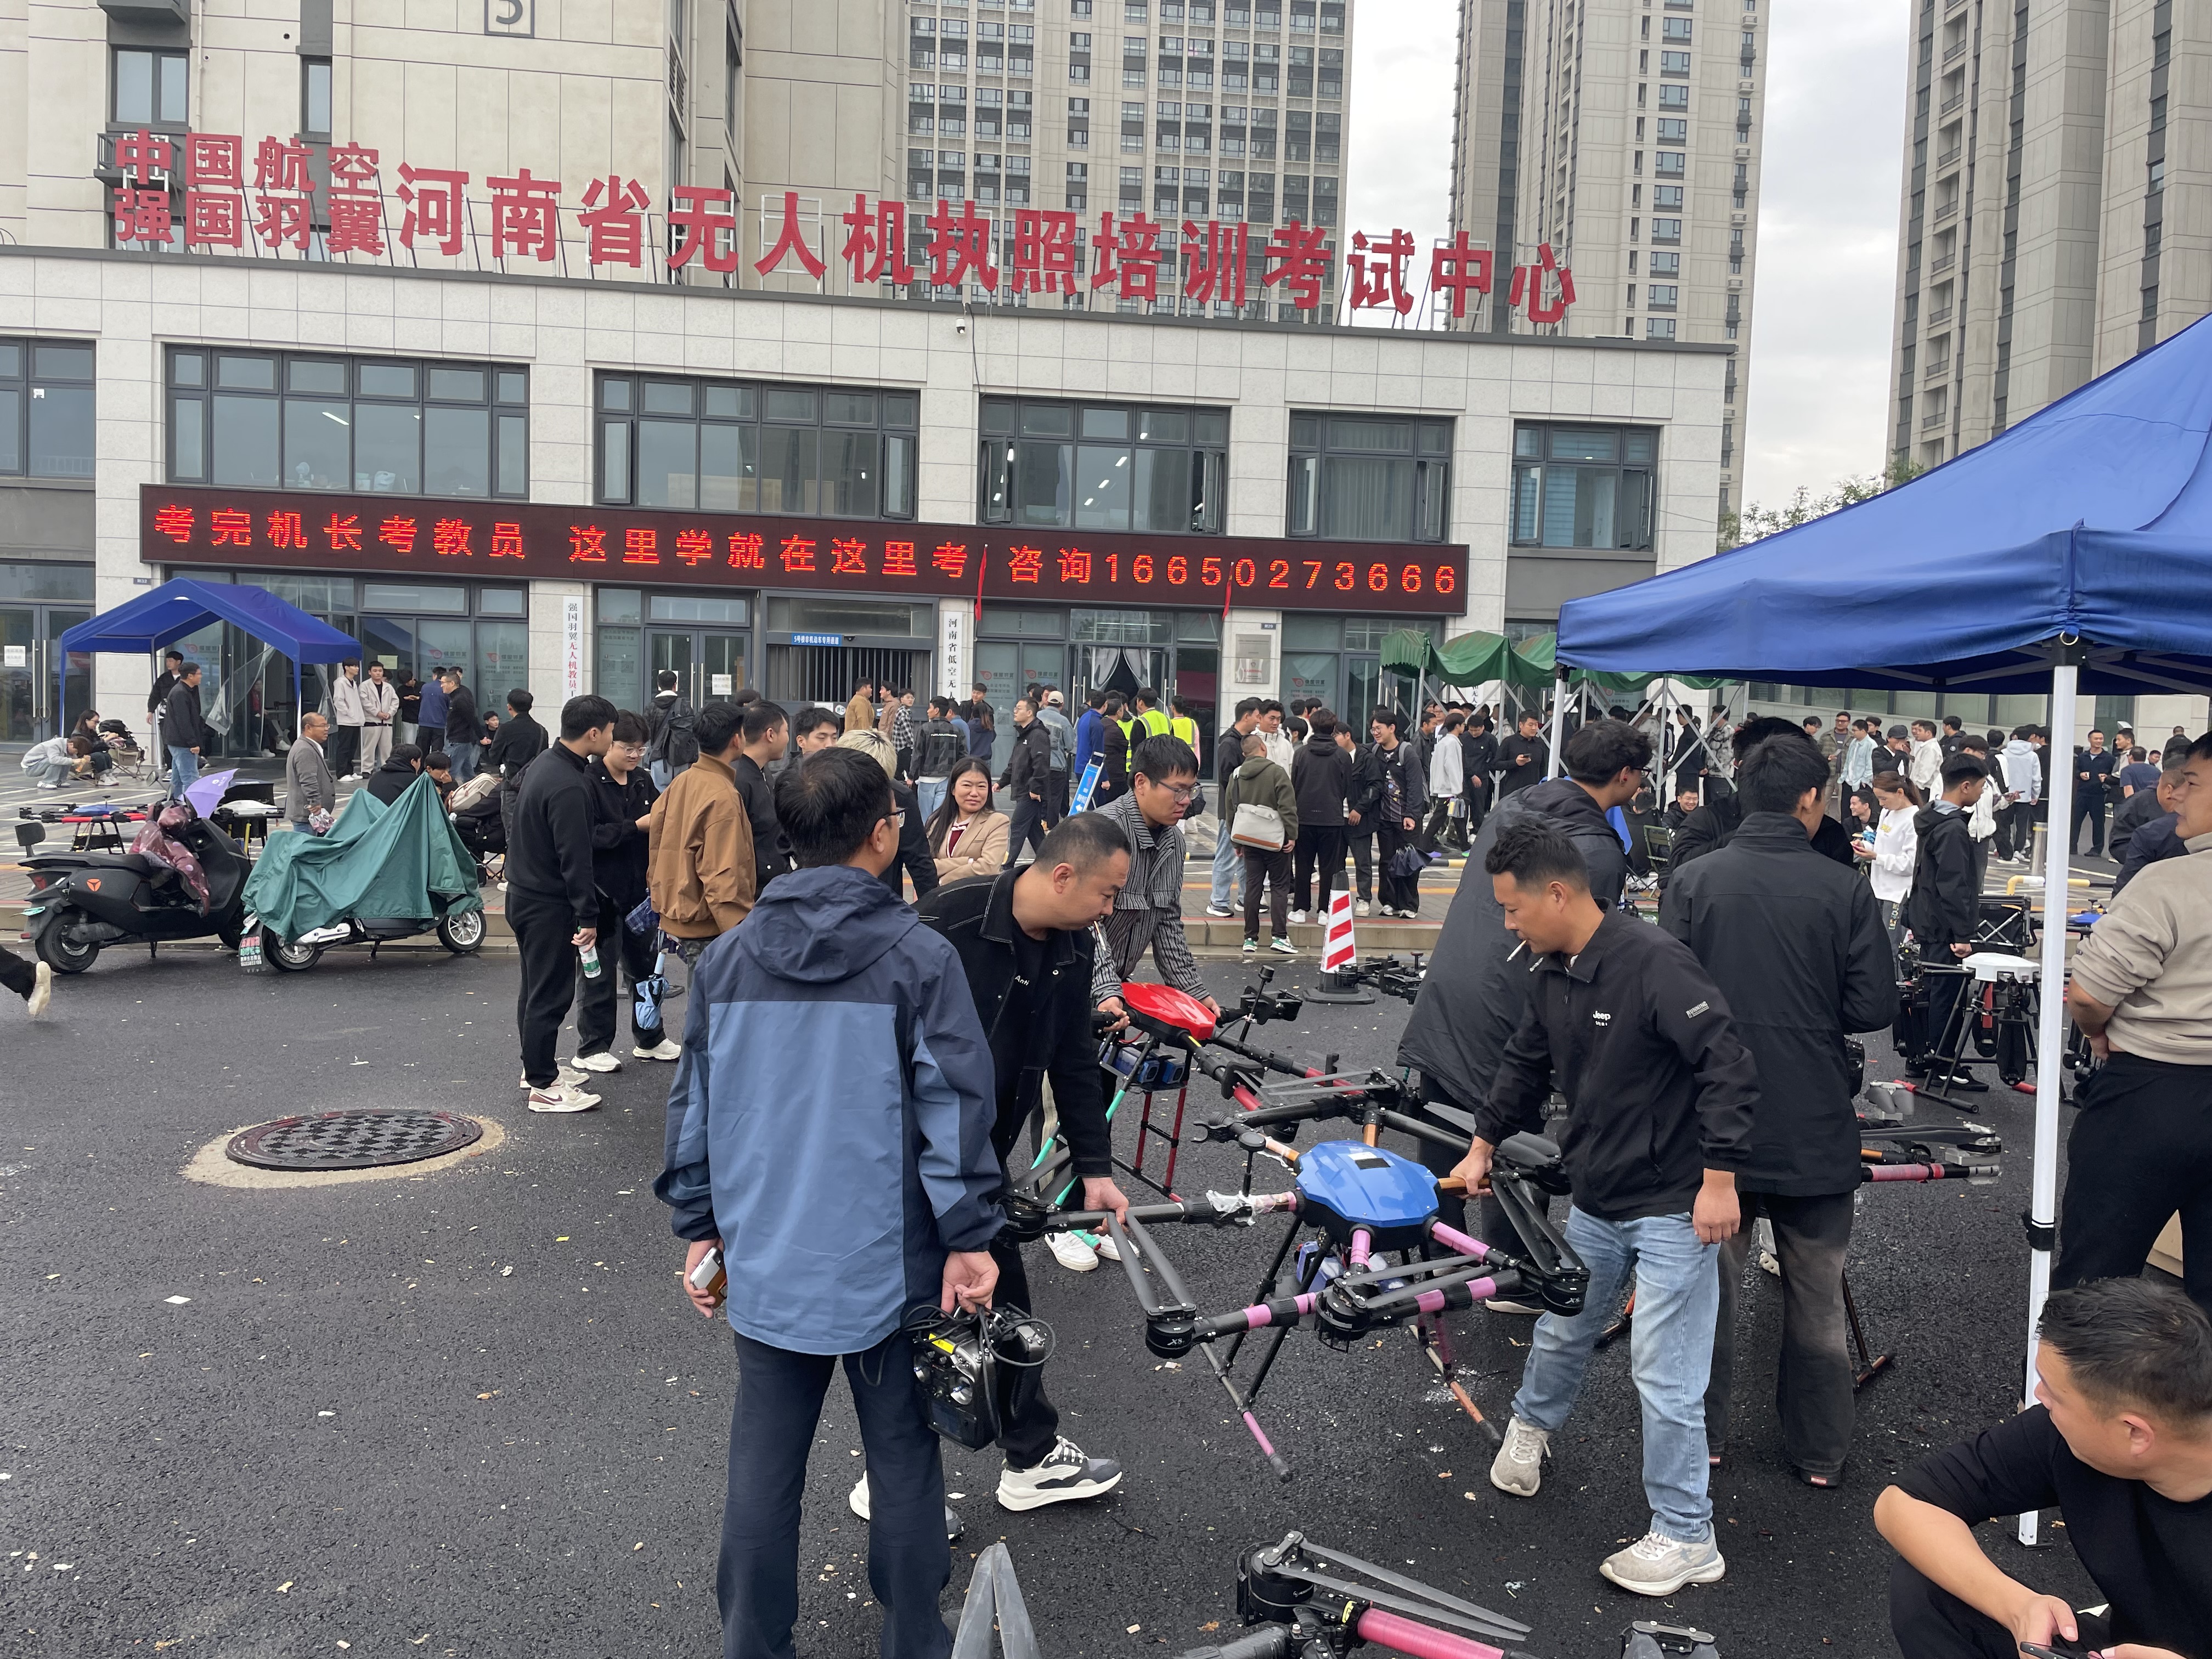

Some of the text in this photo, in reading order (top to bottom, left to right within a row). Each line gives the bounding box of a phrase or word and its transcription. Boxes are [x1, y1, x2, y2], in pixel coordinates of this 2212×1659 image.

[116, 129, 379, 197] 中国航空
[114, 188, 385, 256] 强国羽翼
[396, 161, 1576, 323] 河南省无人机执照培训考试中心
[154, 504, 1455, 594] 考完机长考教员 这里学就在这里考 咨询16650273666
[1593, 1010, 1611, 1020] Jeep
